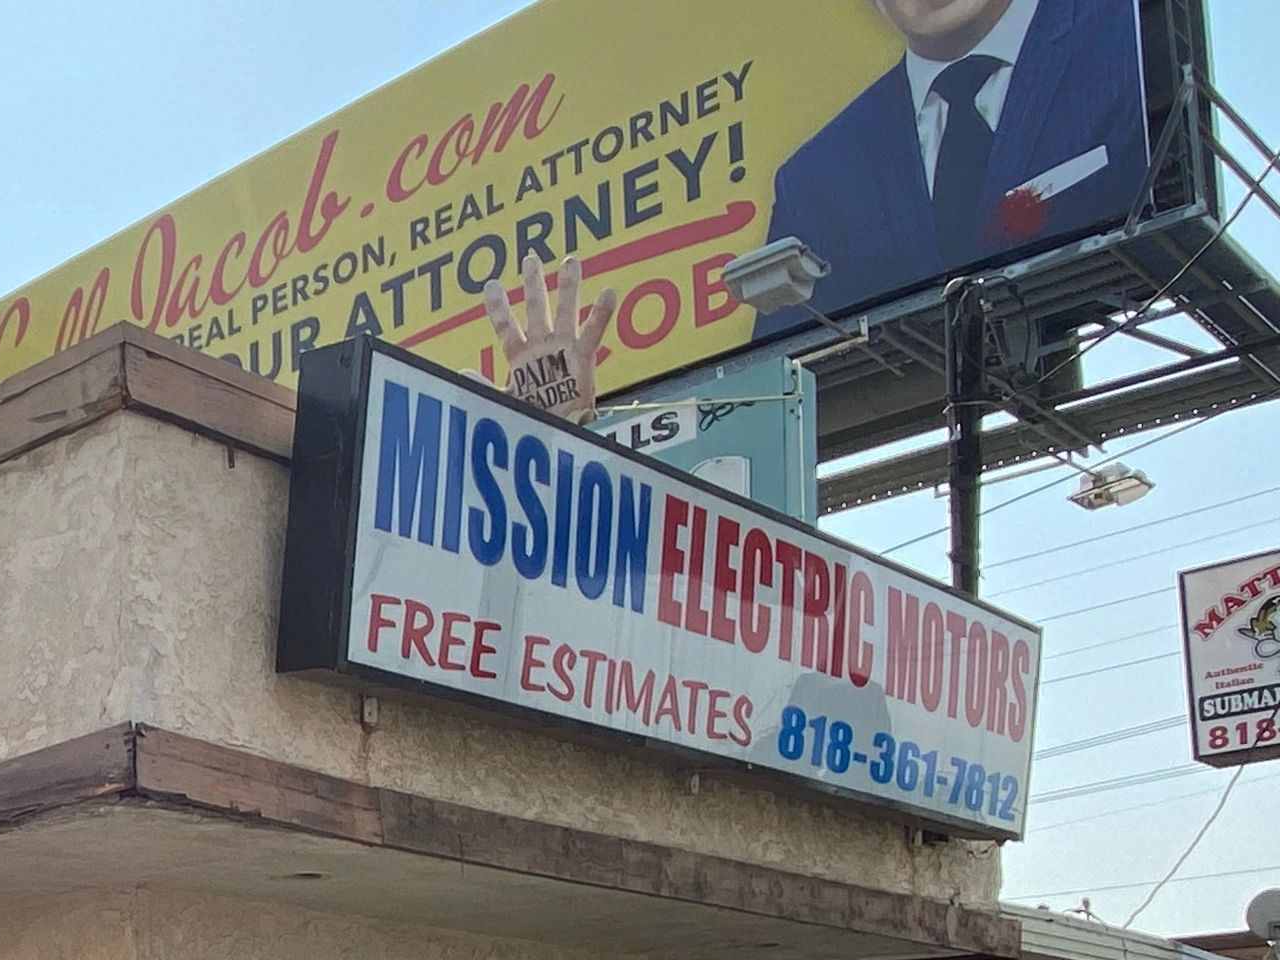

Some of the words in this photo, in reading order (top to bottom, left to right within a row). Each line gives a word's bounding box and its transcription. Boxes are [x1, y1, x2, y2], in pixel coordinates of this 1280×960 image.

[252, 235, 398, 325] PERSON,
[409, 184, 504, 251] REAL
[515, 60, 754, 202] ATTORNEY
[344, 120, 746, 338] ATTORNEY!
[513, 348, 571, 397] PALM
[374, 379, 652, 615] MISSION
[656, 494, 874, 688] ELECTRIC
[885, 587, 1032, 743] MOTORS
[368, 593, 502, 680] FREE
[521, 634, 754, 747] ESTIMATES
[1202, 688, 1280, 718] SUBMA
[1204, 661, 1264, 680] Authentic
[1214, 676, 1255, 691] Italian
[777, 706, 1019, 822] 818-361-7812
